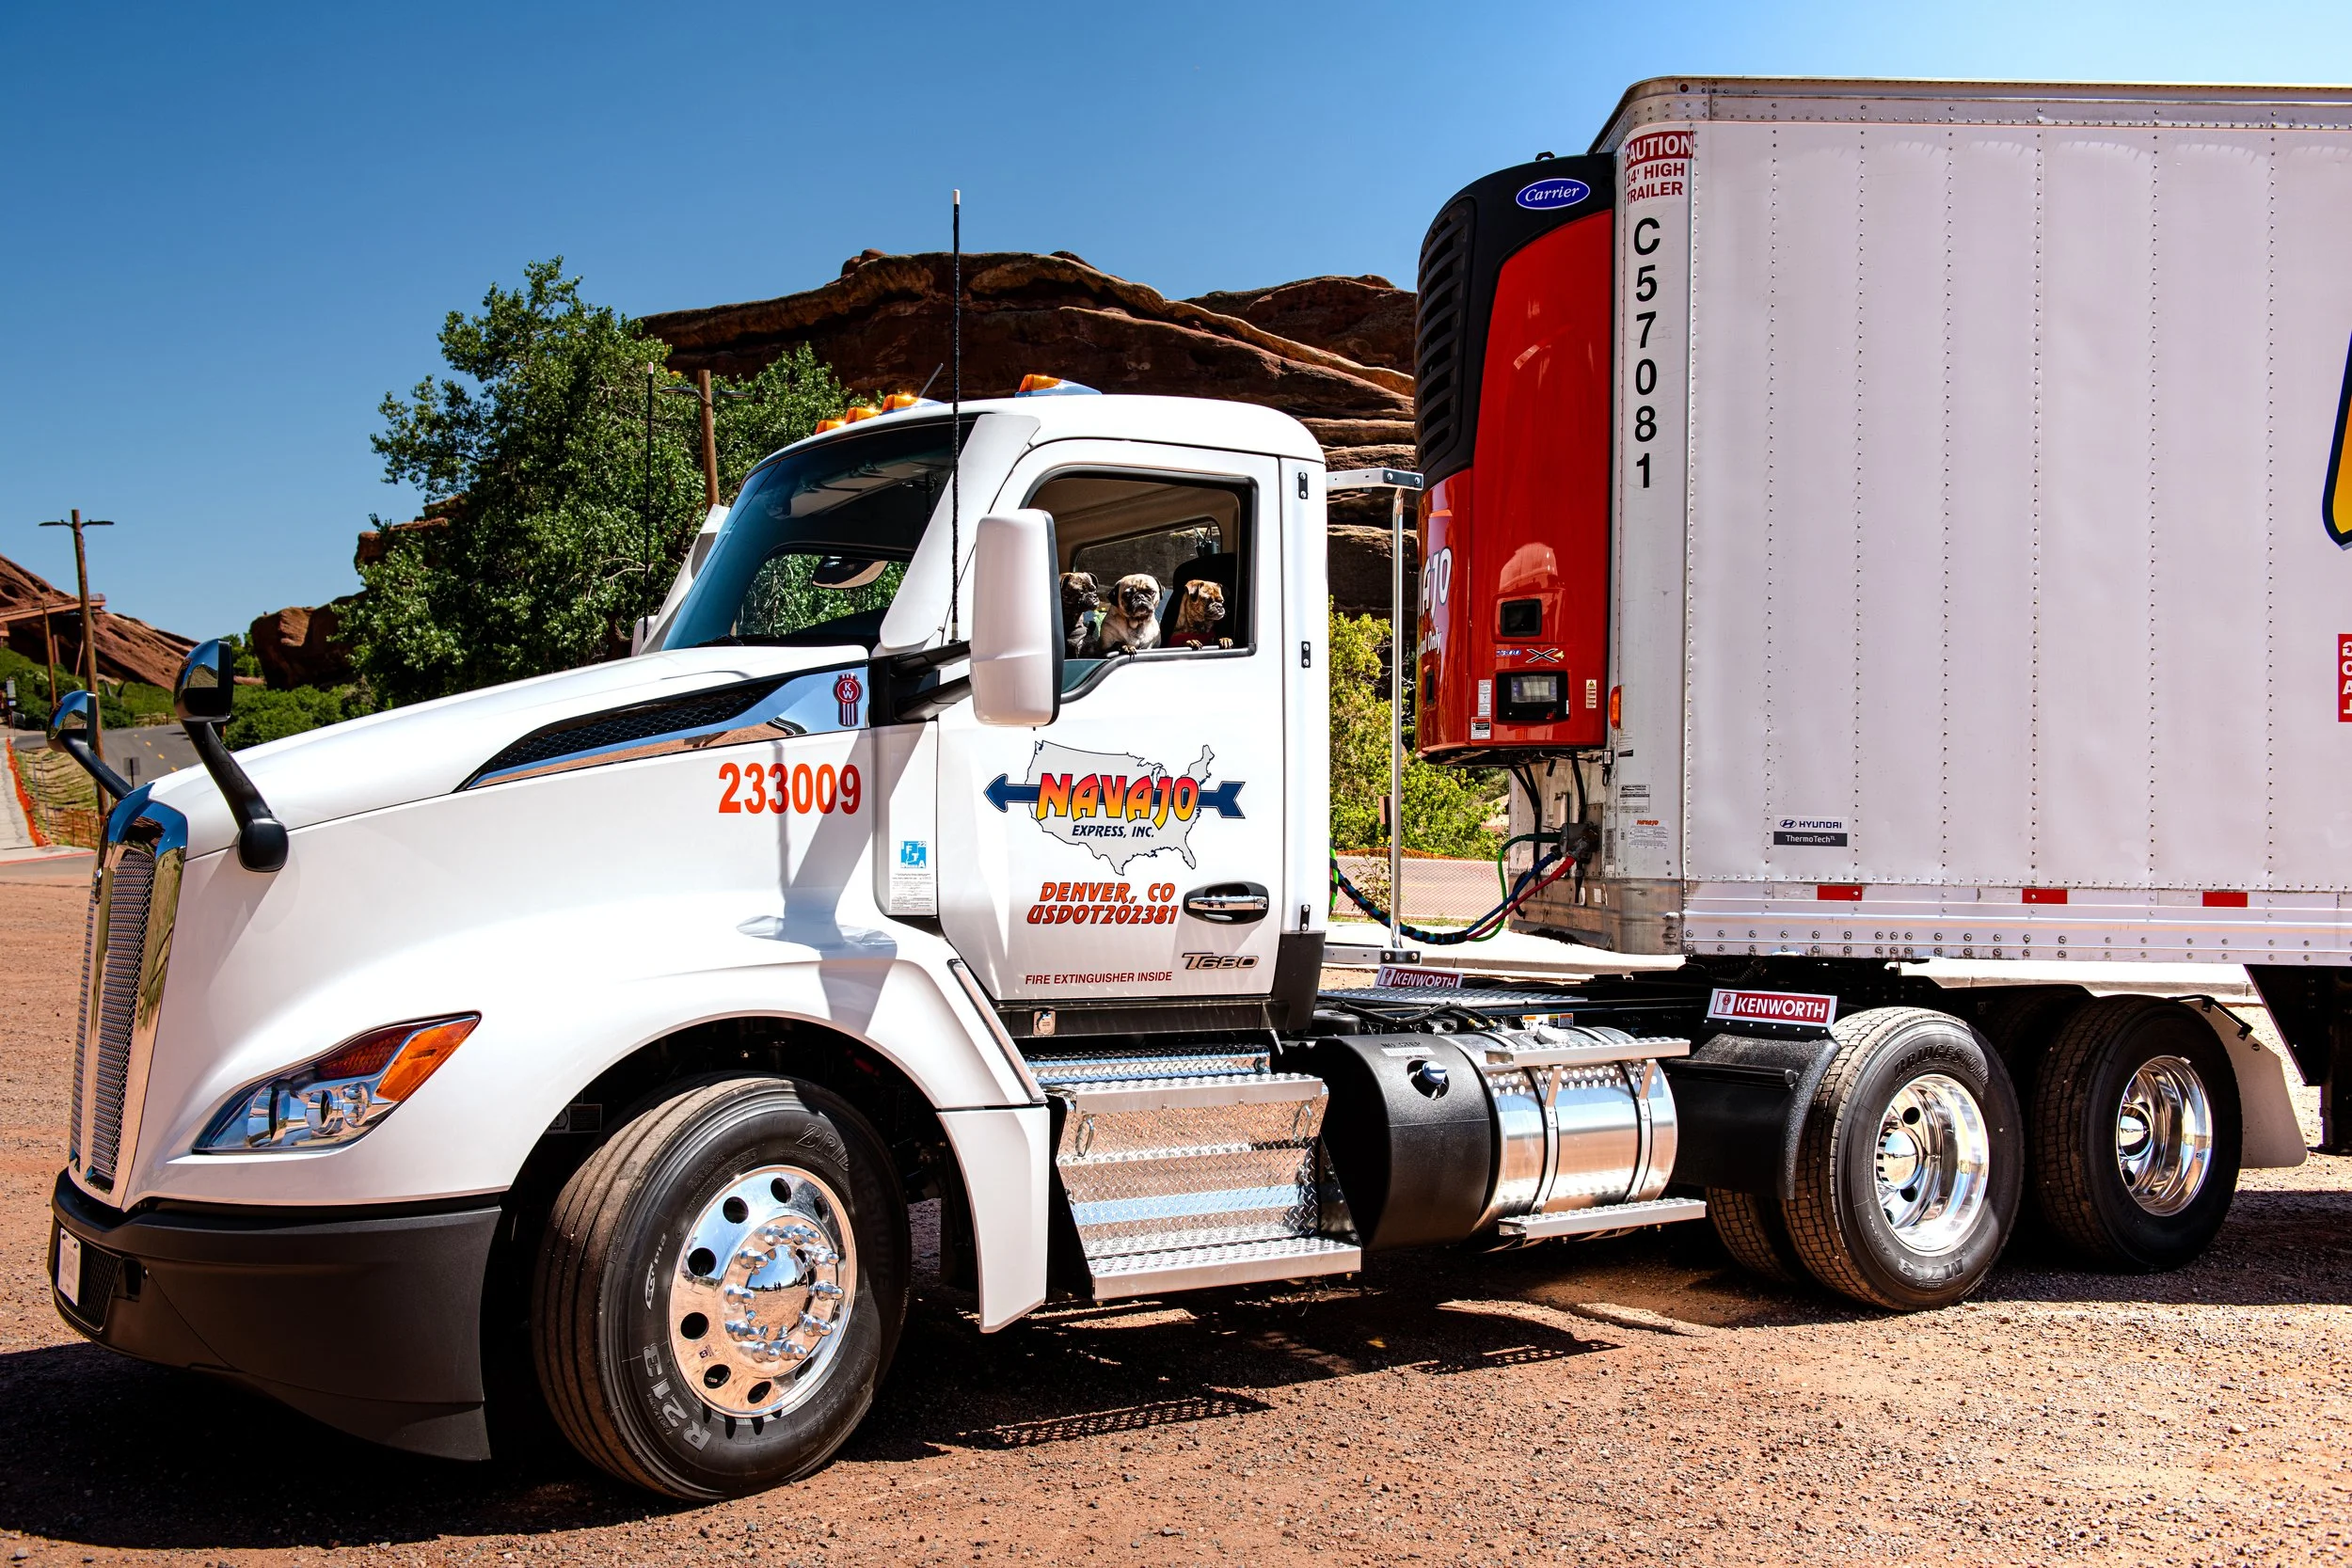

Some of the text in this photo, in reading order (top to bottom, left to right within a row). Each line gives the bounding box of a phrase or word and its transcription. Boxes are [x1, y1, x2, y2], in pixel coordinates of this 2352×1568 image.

[1626, 135, 1692, 167] CAUTION
[1628, 163, 1685, 187] 14' HIGH
[1525, 186, 1580, 202] Carrier
[1627, 182, 1683, 206] TRAILER
[1633, 217, 1661, 488] C57081
[718, 762, 861, 815] 233009
[1035, 773, 1200, 830] NAVAJO
[1072, 825, 1154, 838] EXPRESS, INC.
[1799, 820, 1842, 829] HYUNDAI
[1039, 882, 1176, 904] DENVER, CO
[1026, 905, 1179, 925] USDOT202381
[1182, 952, 1260, 970] T680
[1025, 972, 1172, 985] FIRE EXTINGUISHER INSIDE
[1393, 972, 1456, 988] KENWORTH
[1736, 997, 1826, 1018] KENWORTH
[643, 1342, 712, 1452] R213
